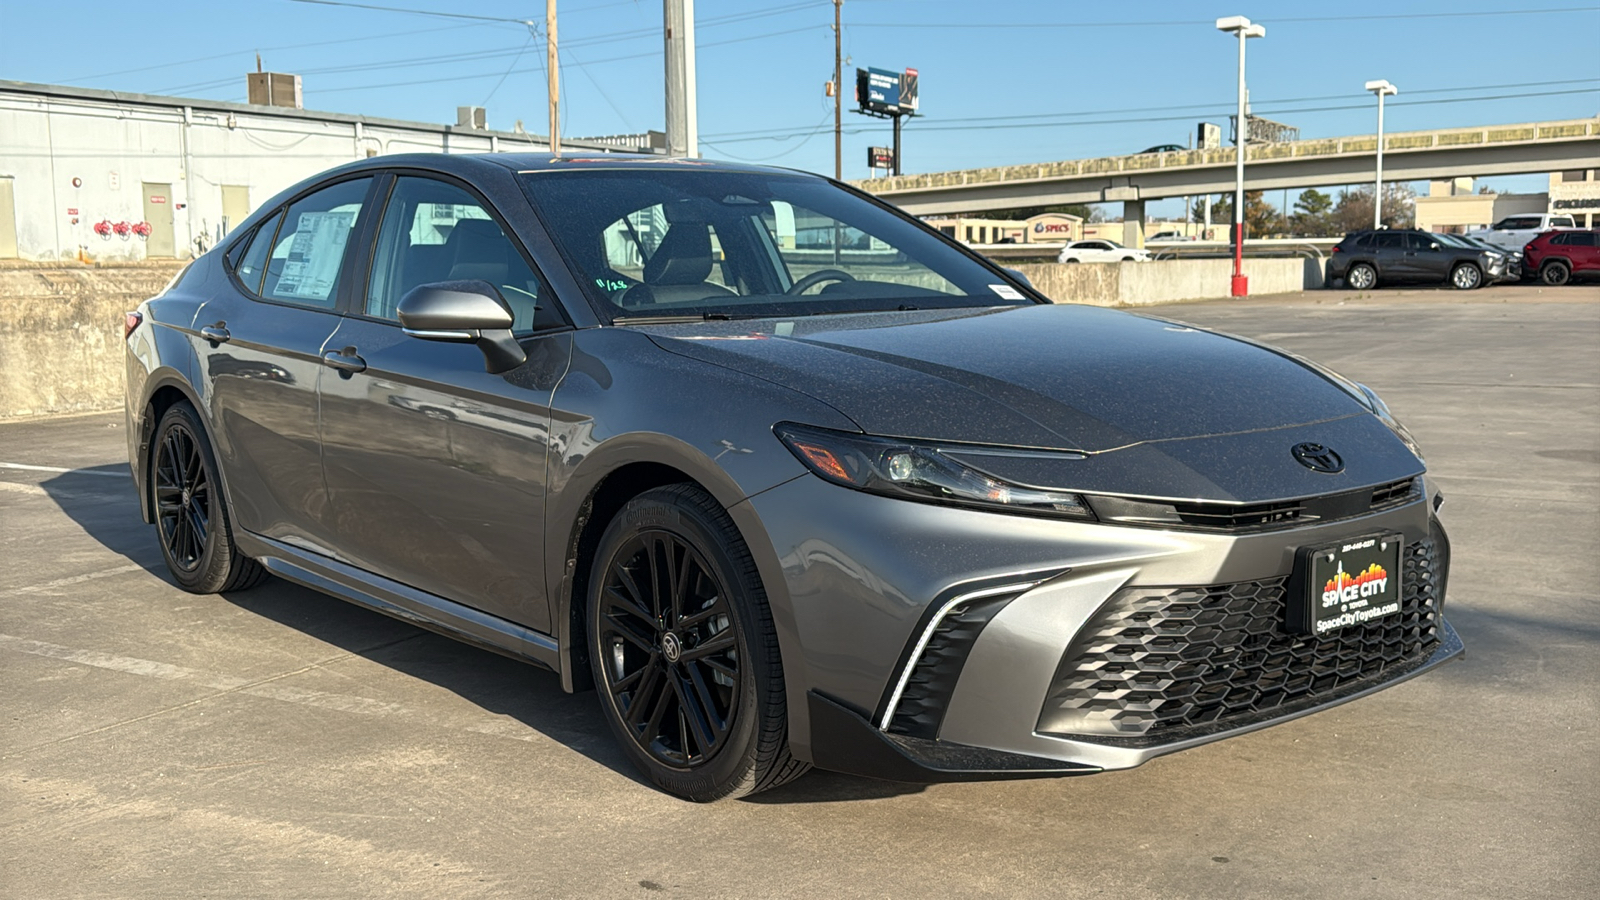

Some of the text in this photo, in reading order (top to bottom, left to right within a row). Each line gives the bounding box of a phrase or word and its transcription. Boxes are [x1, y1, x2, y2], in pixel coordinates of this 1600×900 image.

[1322, 577, 1388, 608] SPACE CITY
[1317, 603, 1398, 632] SpaceCityToyota.com
